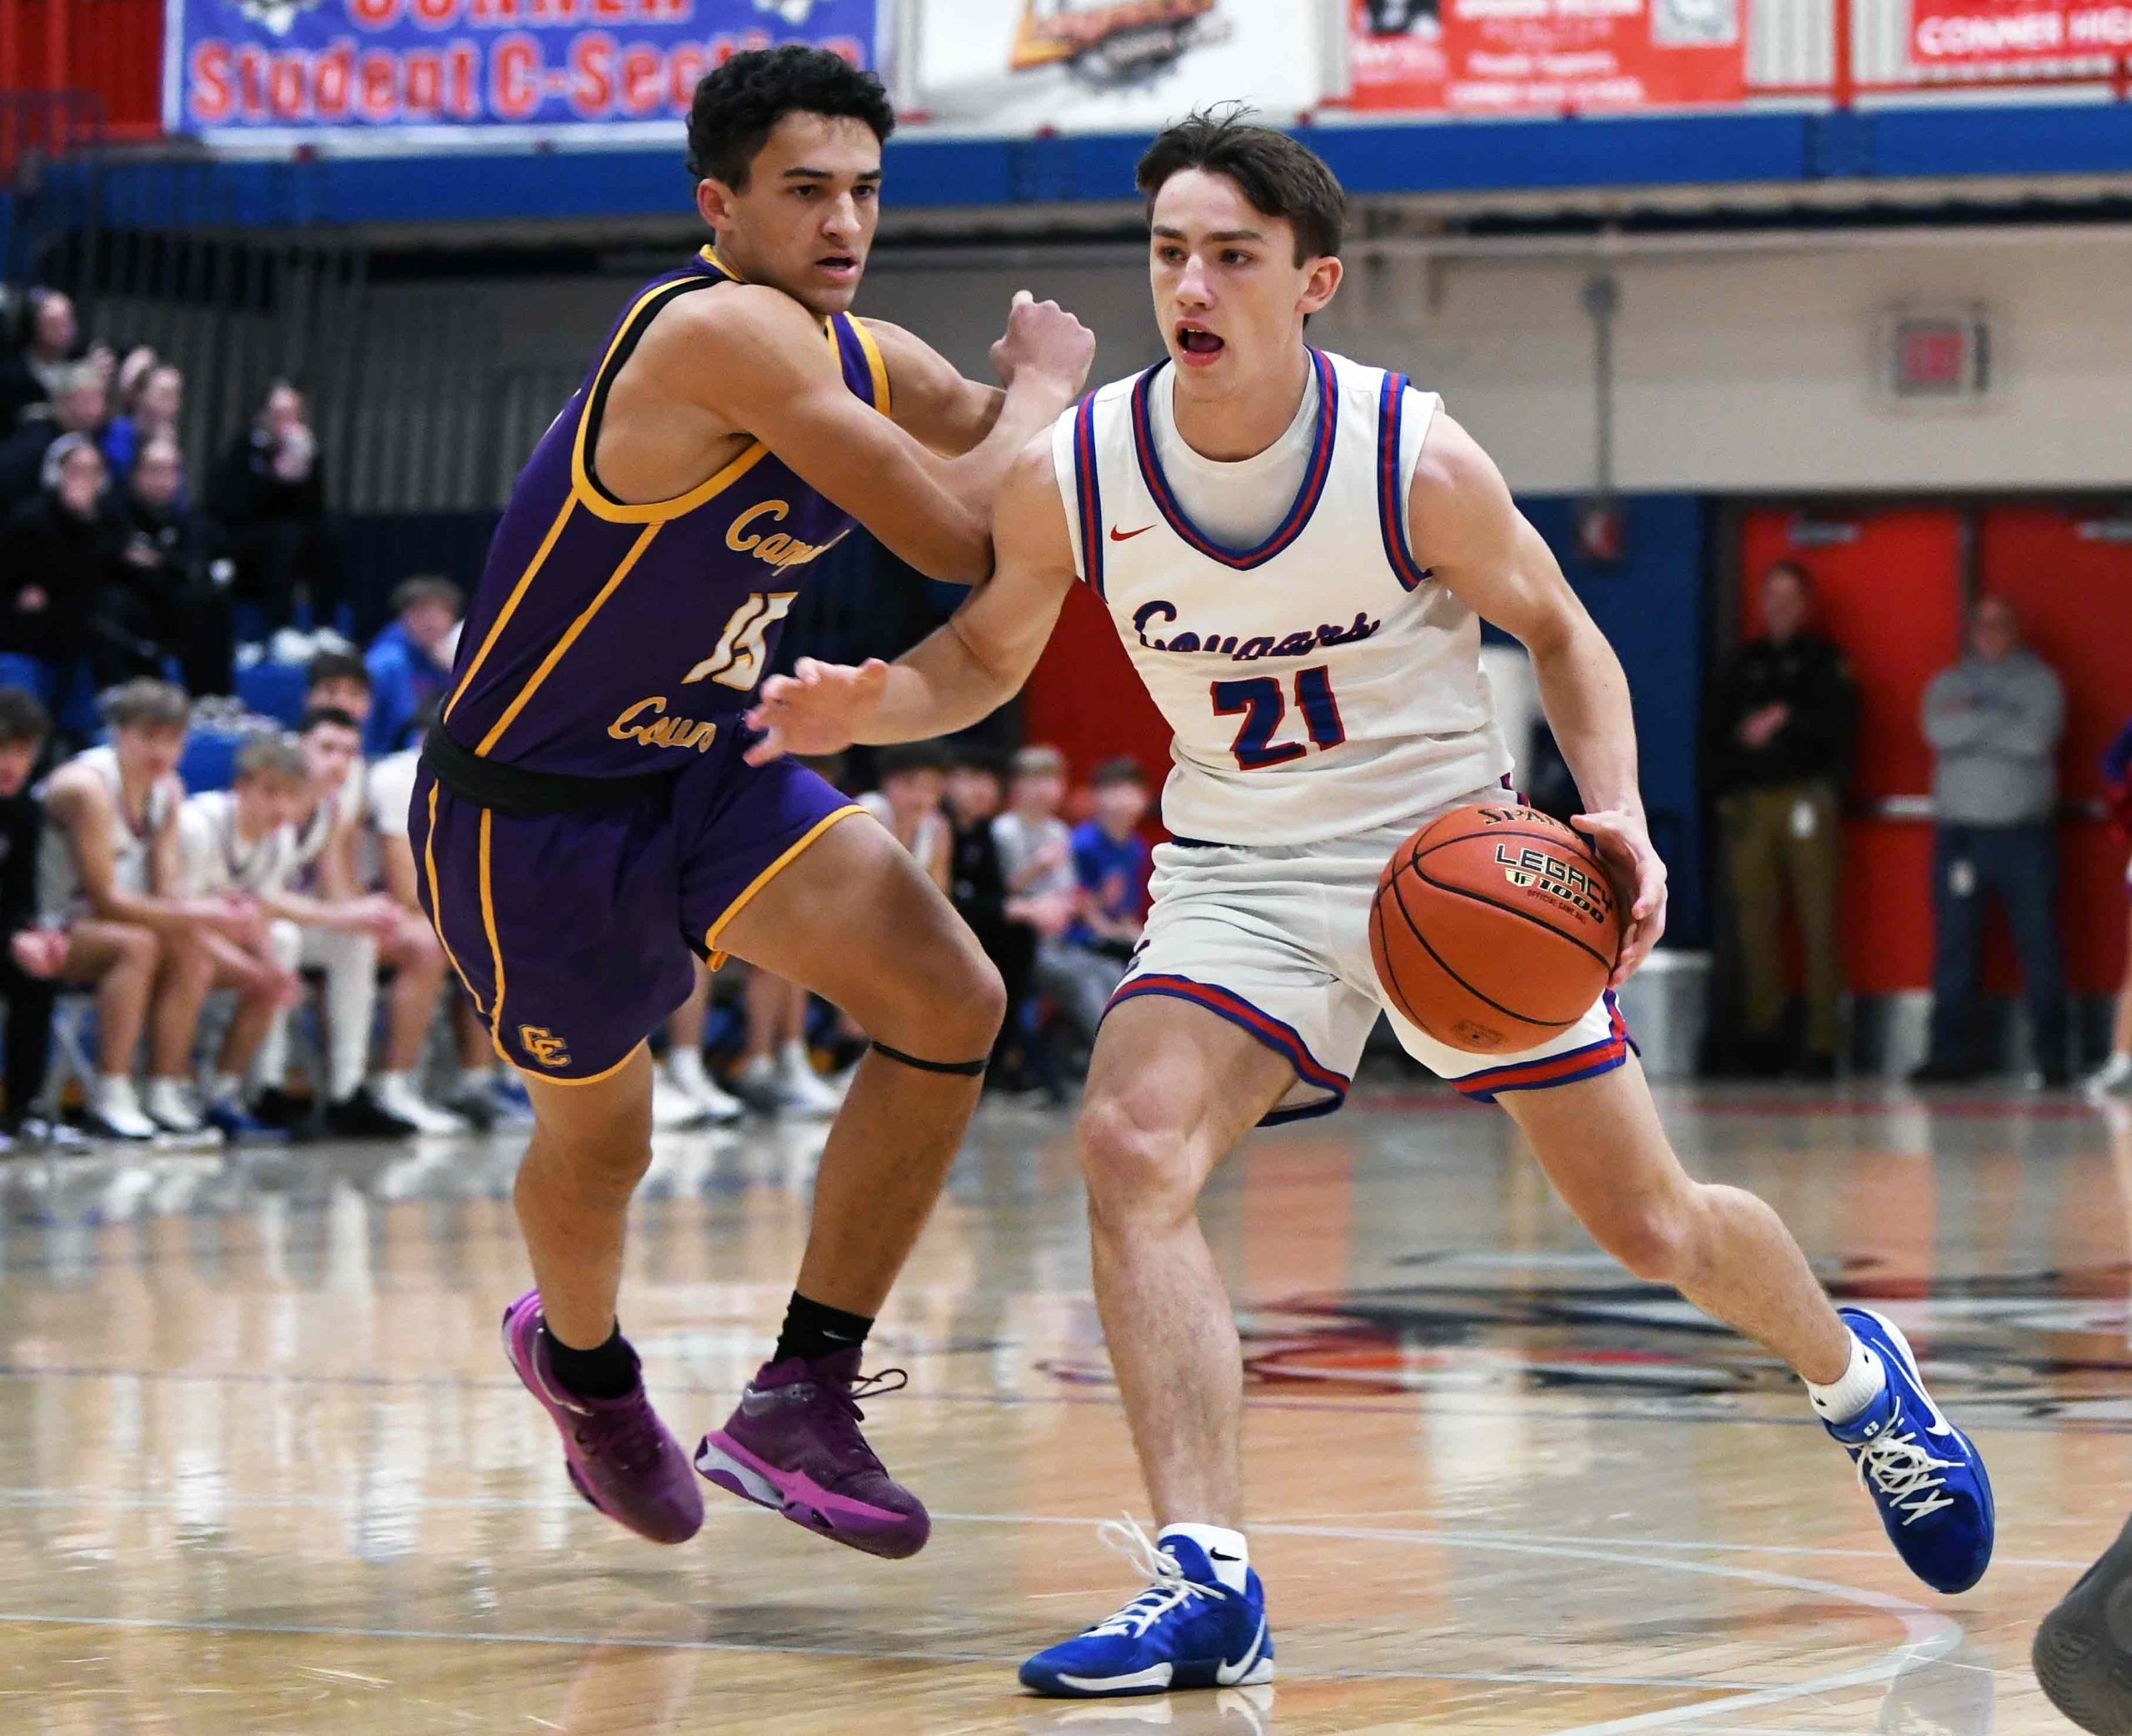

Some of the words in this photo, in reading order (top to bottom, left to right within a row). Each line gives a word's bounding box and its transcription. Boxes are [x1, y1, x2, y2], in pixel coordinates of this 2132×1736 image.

[190, 35, 483, 122] Student
[680, 591, 799, 692] 15
[1132, 600, 1381, 661] Cougars
[1210, 664, 1347, 771] 21
[1495, 843, 1612, 913] LEGACY
